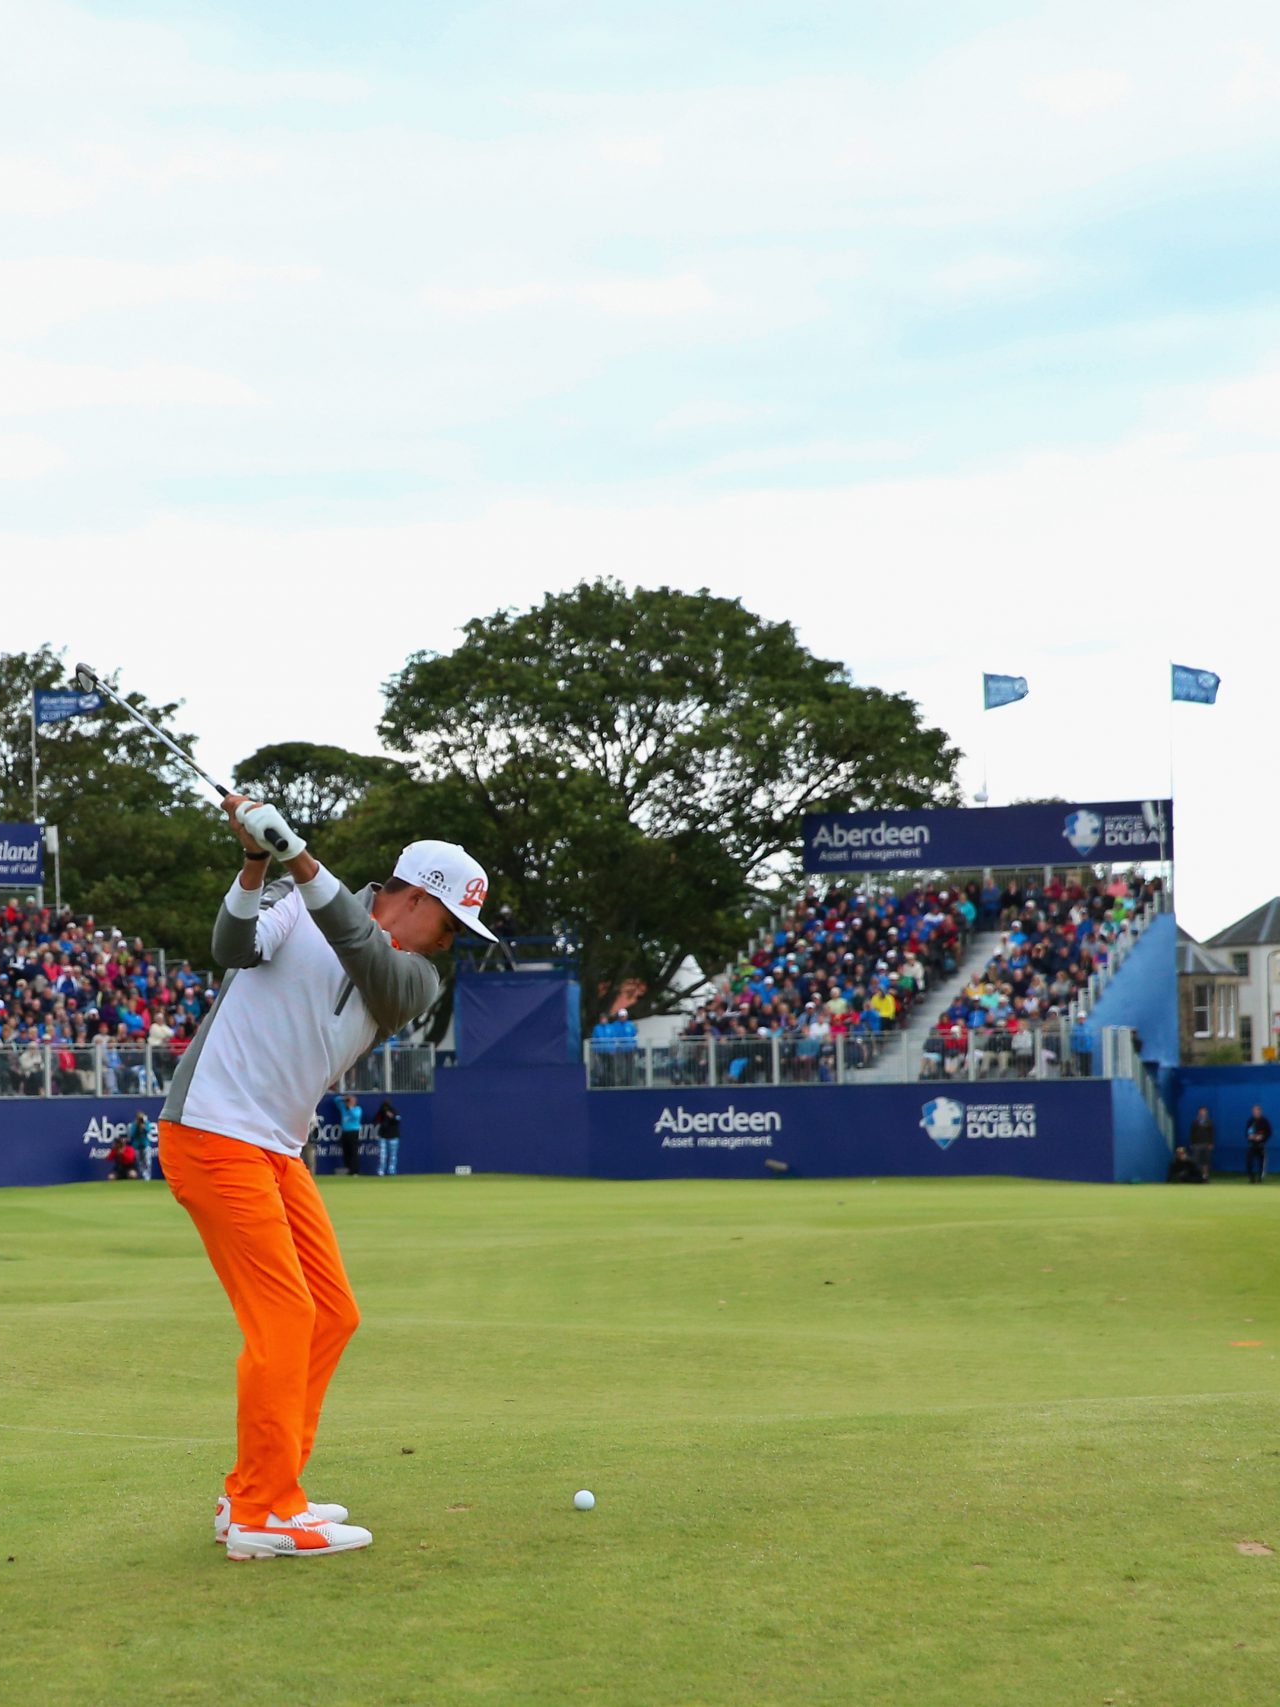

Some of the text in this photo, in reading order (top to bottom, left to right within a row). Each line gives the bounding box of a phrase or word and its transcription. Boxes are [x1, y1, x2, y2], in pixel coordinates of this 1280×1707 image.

[812, 820, 931, 848] Aberdeen
[1104, 829, 1167, 846] DUBAI
[819, 847, 922, 862] Asset management
[19, 864, 37, 875] Golf
[417, 871, 452, 893] FARMERS
[654, 1105, 782, 1133] Aberdeen
[966, 1110, 1035, 1122] RACE TO
[83, 1115, 158, 1144] Abee
[312, 1115, 380, 1141] Scon
[966, 1121, 1036, 1138] DUBAI
[661, 1135, 773, 1150] Asset management
